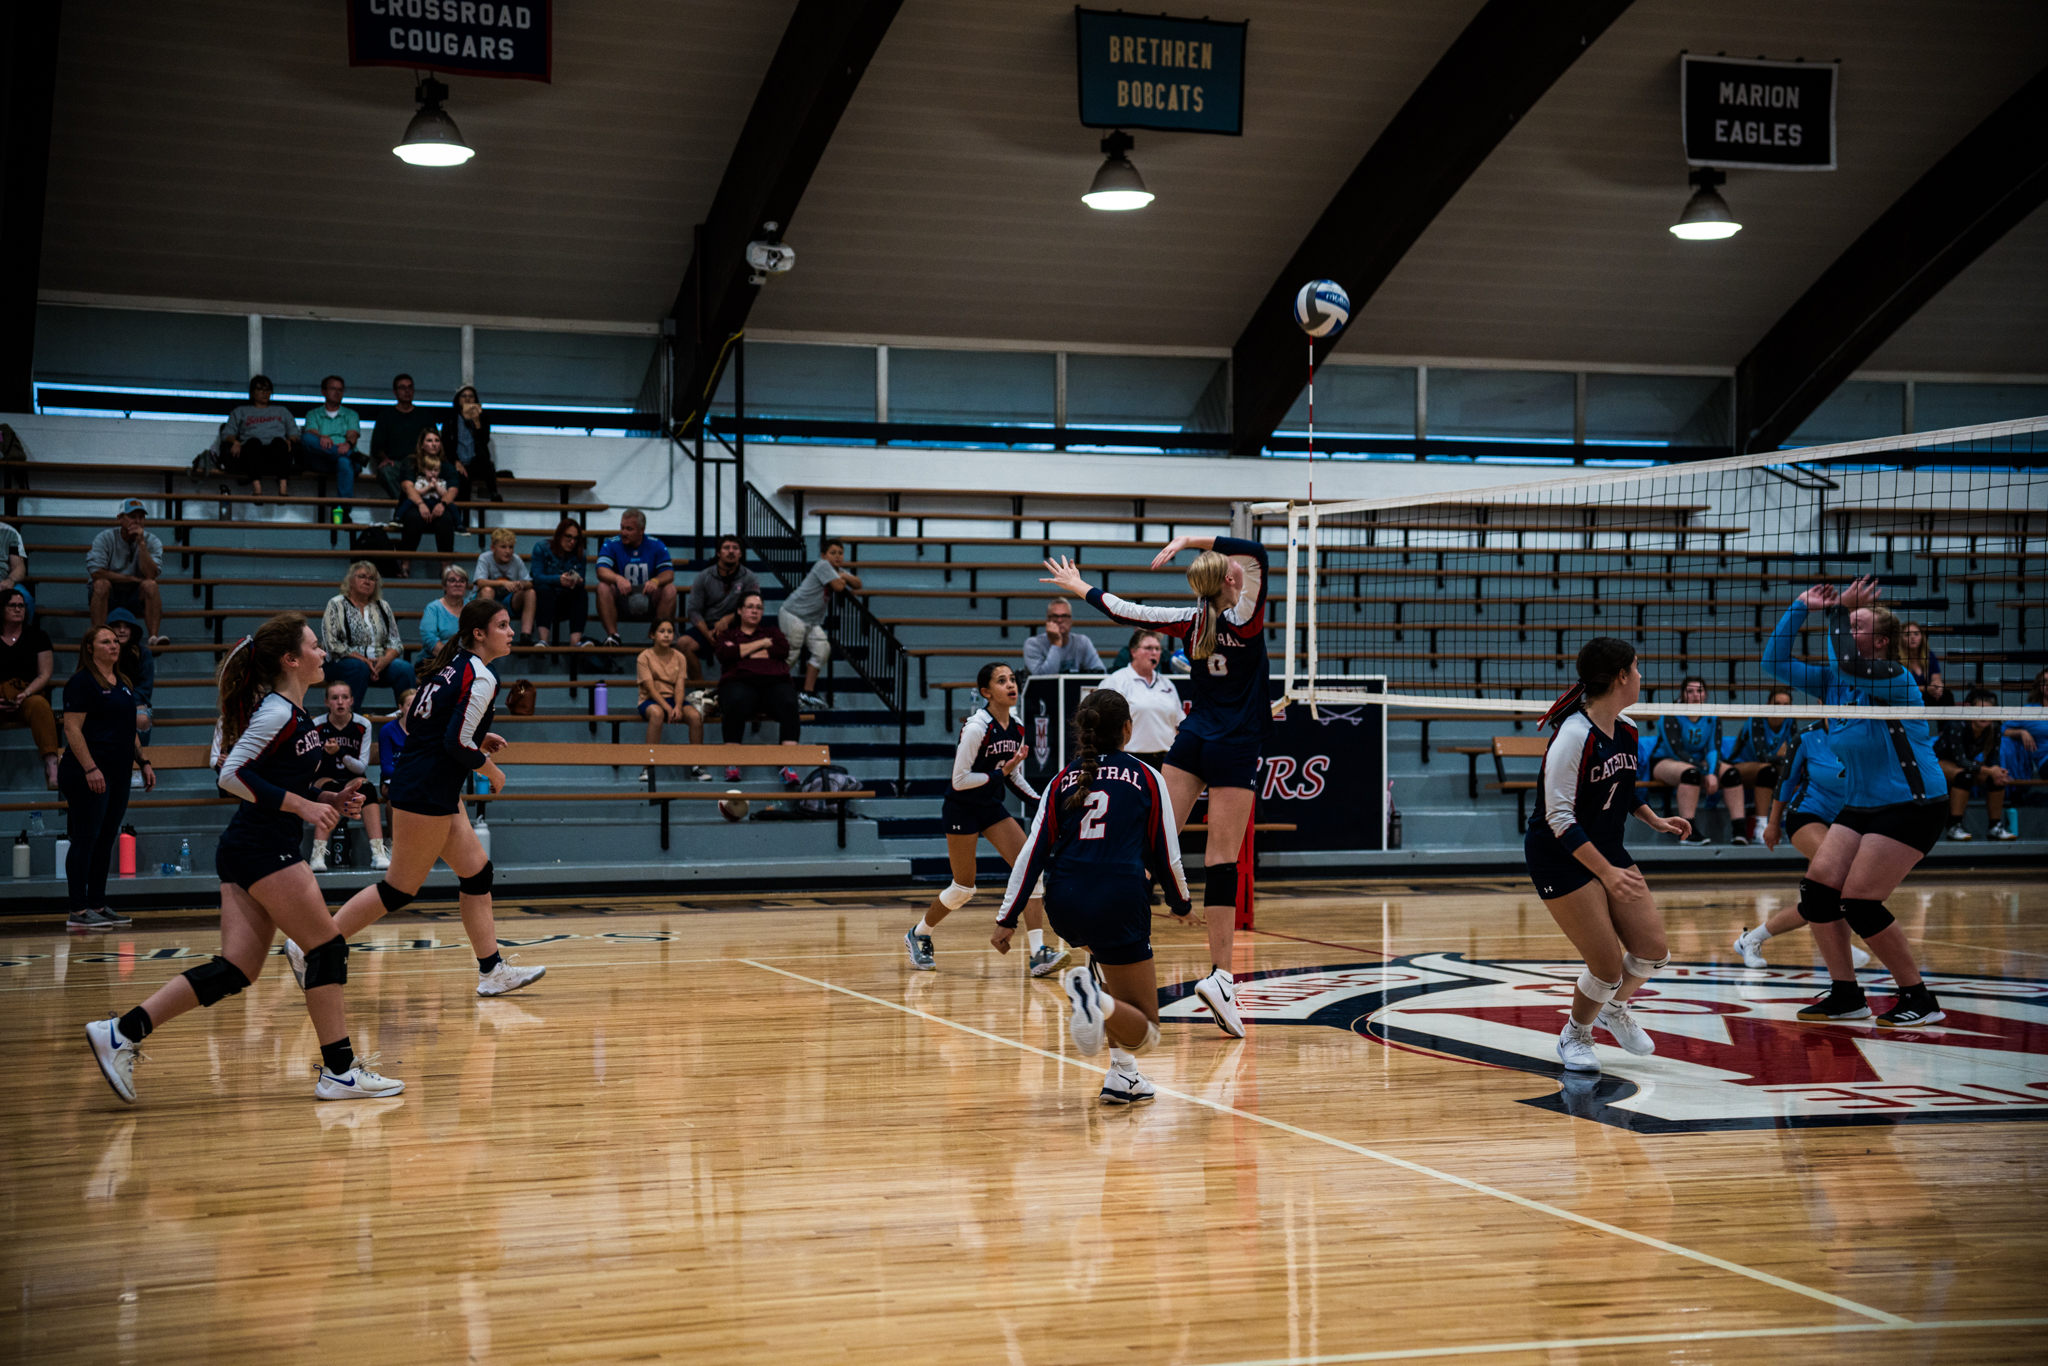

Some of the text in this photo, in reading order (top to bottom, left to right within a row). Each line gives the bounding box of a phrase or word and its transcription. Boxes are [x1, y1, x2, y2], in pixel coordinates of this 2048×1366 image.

[370, 0, 531, 30] CROSSROAD
[389, 27, 515, 61] COUGARS
[1109, 35, 1213, 70] BRETHREN
[1117, 80, 1204, 113] BOBCATS
[1719, 81, 1800, 110] MARION
[1715, 119, 1803, 147] EAGLES
[624, 563, 649, 586] 81
[413, 682, 441, 720] 15
[1061, 766, 1142, 793] CETRAL
[1601, 780, 1620, 811] 1
[1079, 789, 1111, 840] 2
